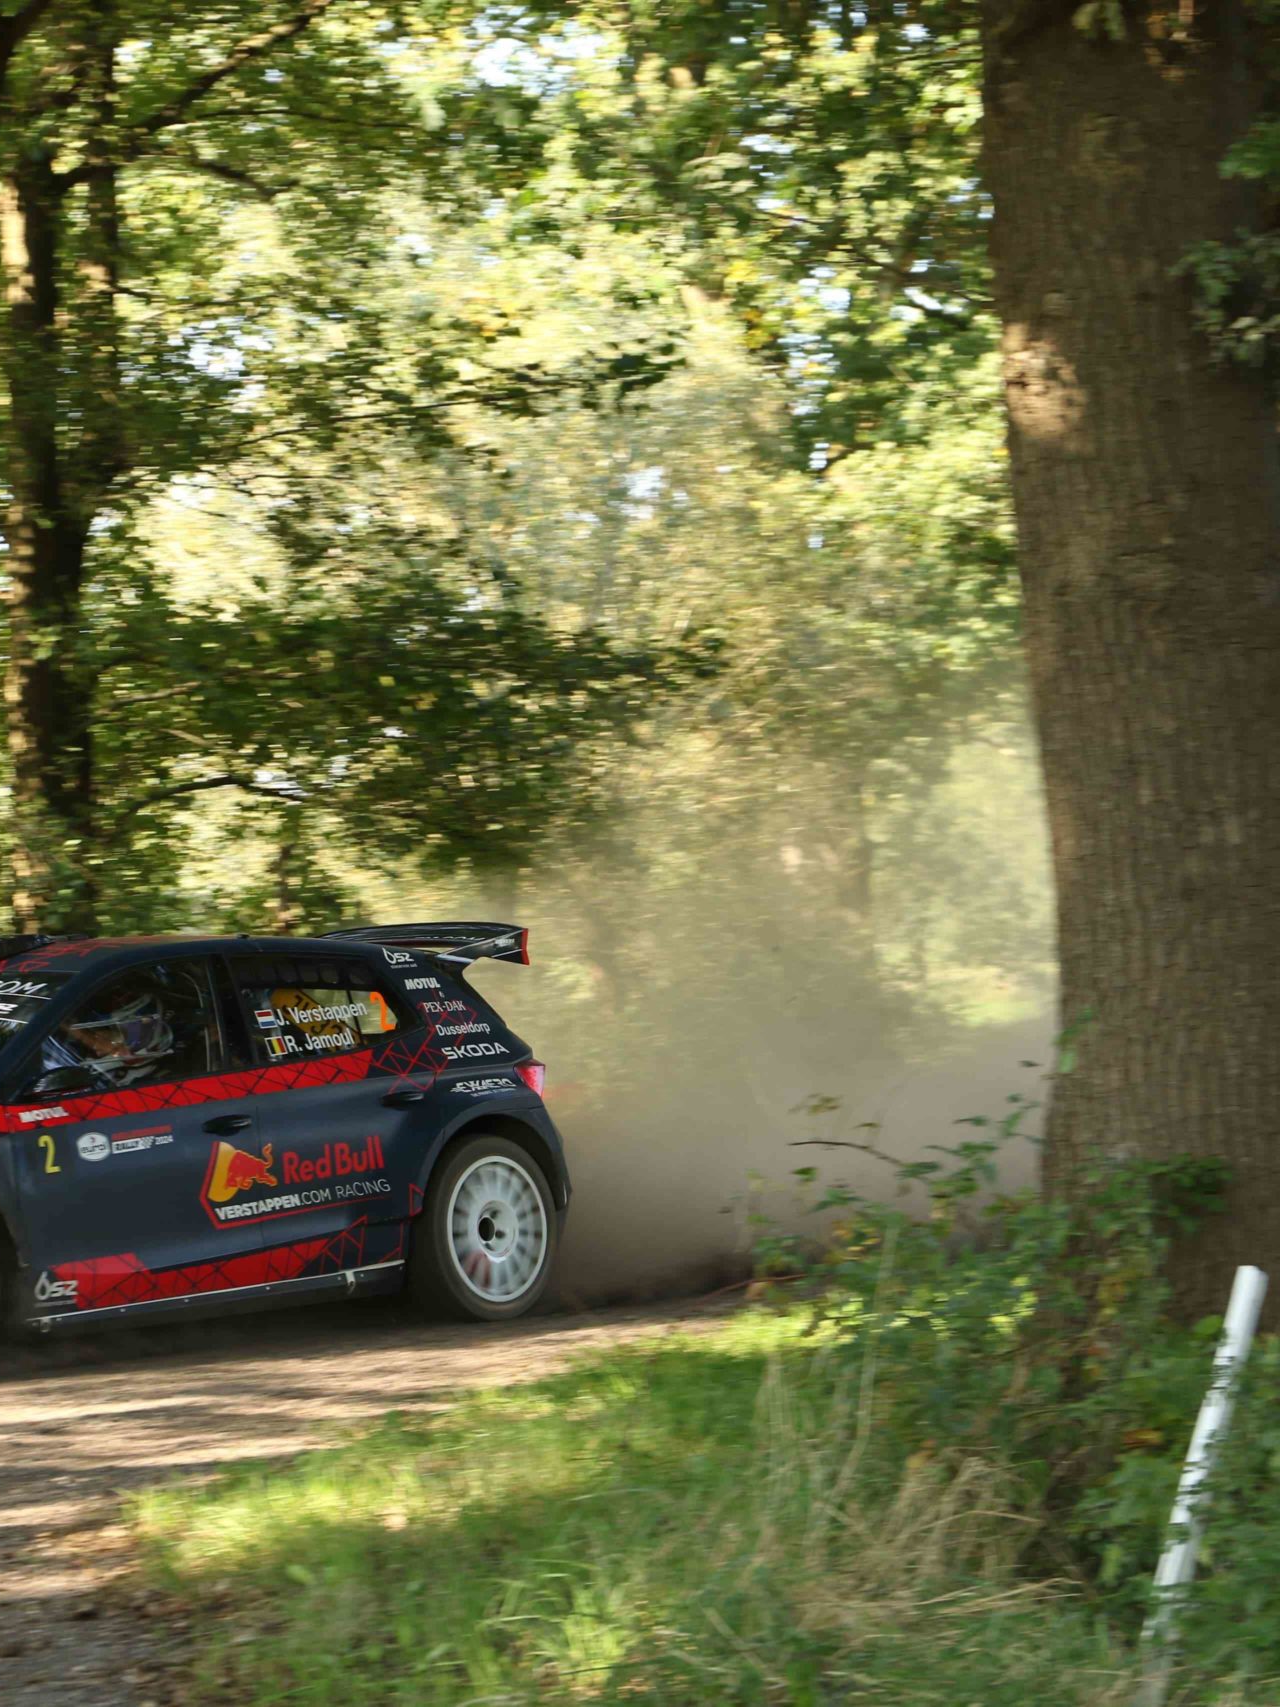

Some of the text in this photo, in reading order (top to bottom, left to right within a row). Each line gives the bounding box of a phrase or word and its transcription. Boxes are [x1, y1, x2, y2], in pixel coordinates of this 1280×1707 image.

[404, 977, 441, 990] MOTUL
[275, 1002, 368, 1026] J. Verstappen
[369, 991, 396, 1031] 2
[423, 1000, 467, 1013] PEX-DAK
[283, 1027, 355, 1053] R. Jamoul
[435, 1021, 491, 1036] Dusseldorp
[18, 1106, 69, 1123] MOTUL
[38, 1134, 61, 1174] 2
[282, 1134, 385, 1184] Red Bull
[214, 1178, 391, 1220] VERSTAPPEN.COM RACING
